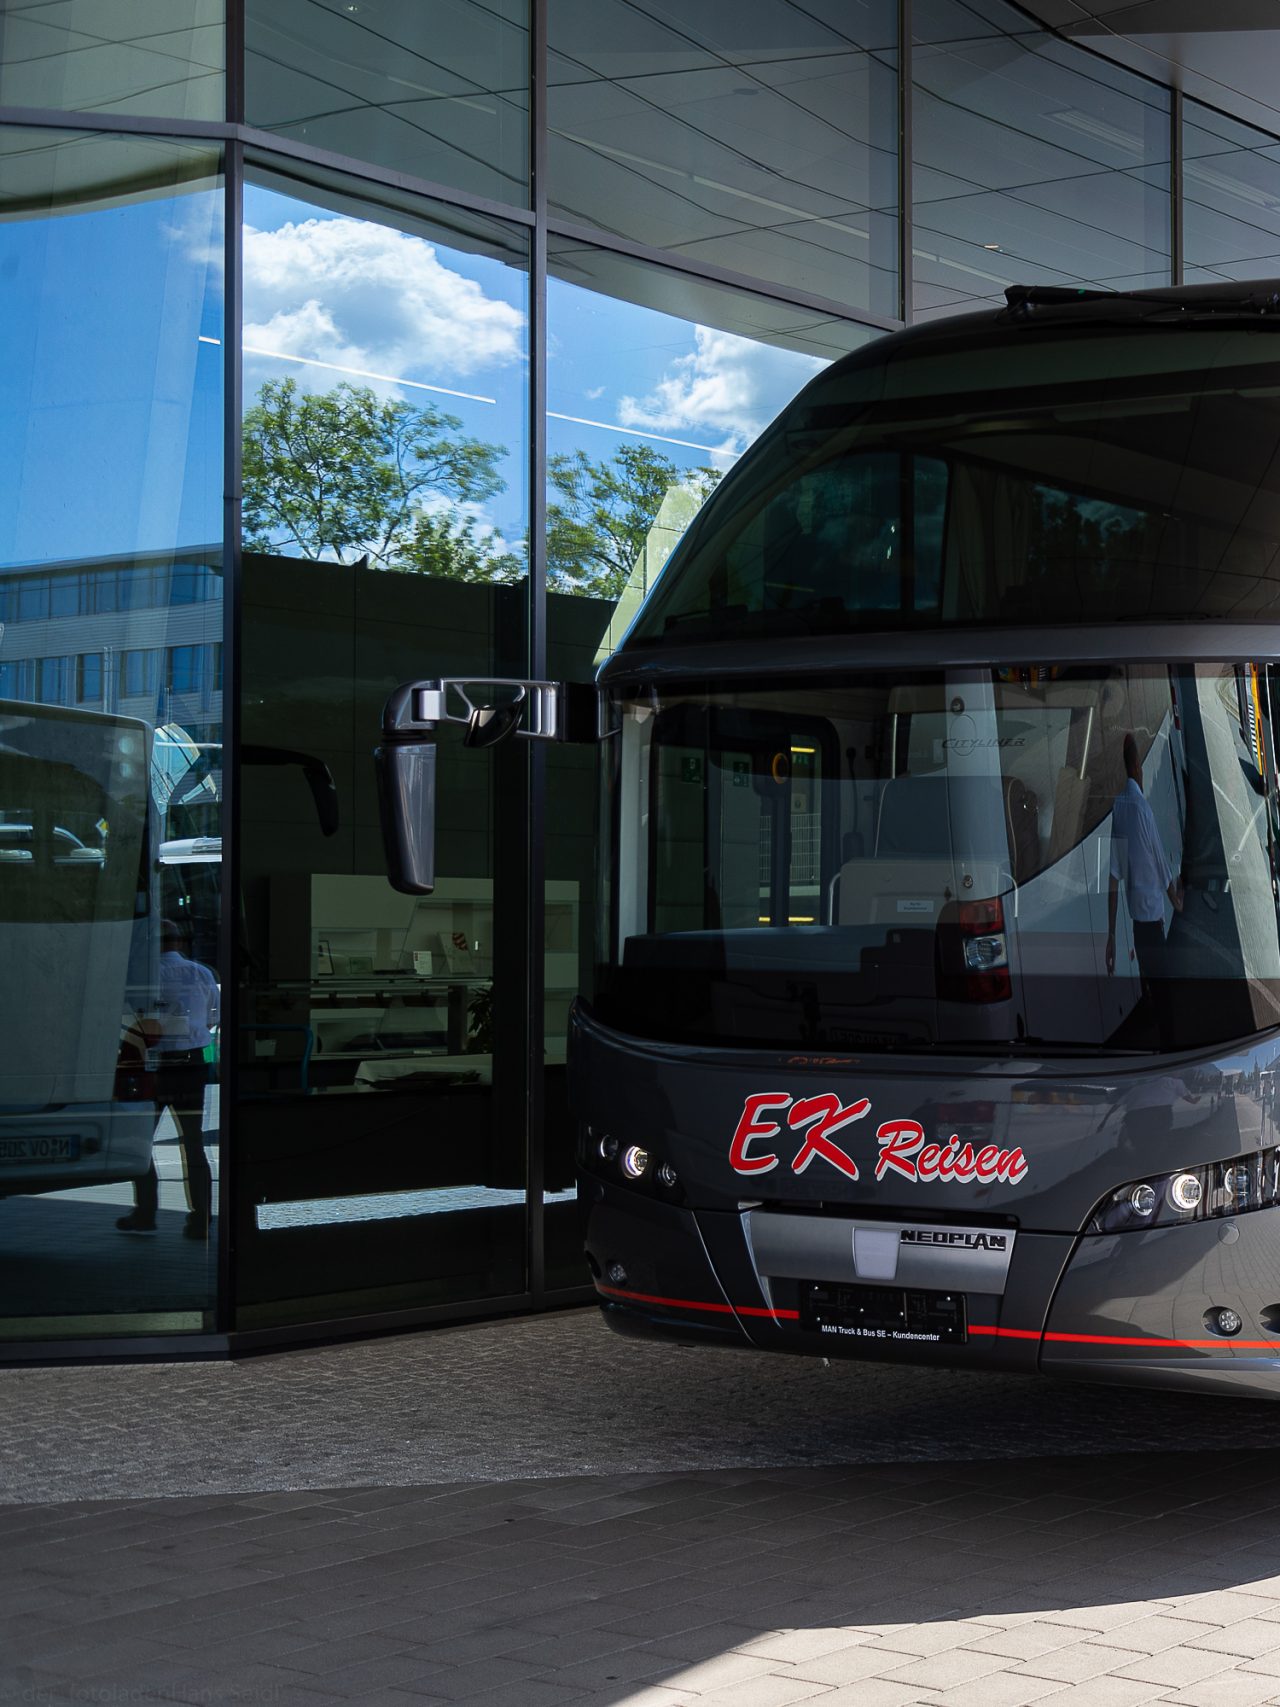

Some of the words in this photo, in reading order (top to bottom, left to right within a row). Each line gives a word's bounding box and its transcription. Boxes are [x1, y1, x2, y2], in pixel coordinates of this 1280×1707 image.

[942, 737, 1026, 748] CITYLINER
[728, 1092, 872, 1181] EK
[875, 1119, 1030, 1185] Reisen
[900, 1229, 1007, 1251] NEOPLAN
[821, 1324, 838, 1333] MAN
[838, 1326, 856, 1335] Truck
[862, 1329, 876, 1337] Bus
[876, 1329, 887, 1338] SE
[892, 1331, 940, 1341] Kundencenter
